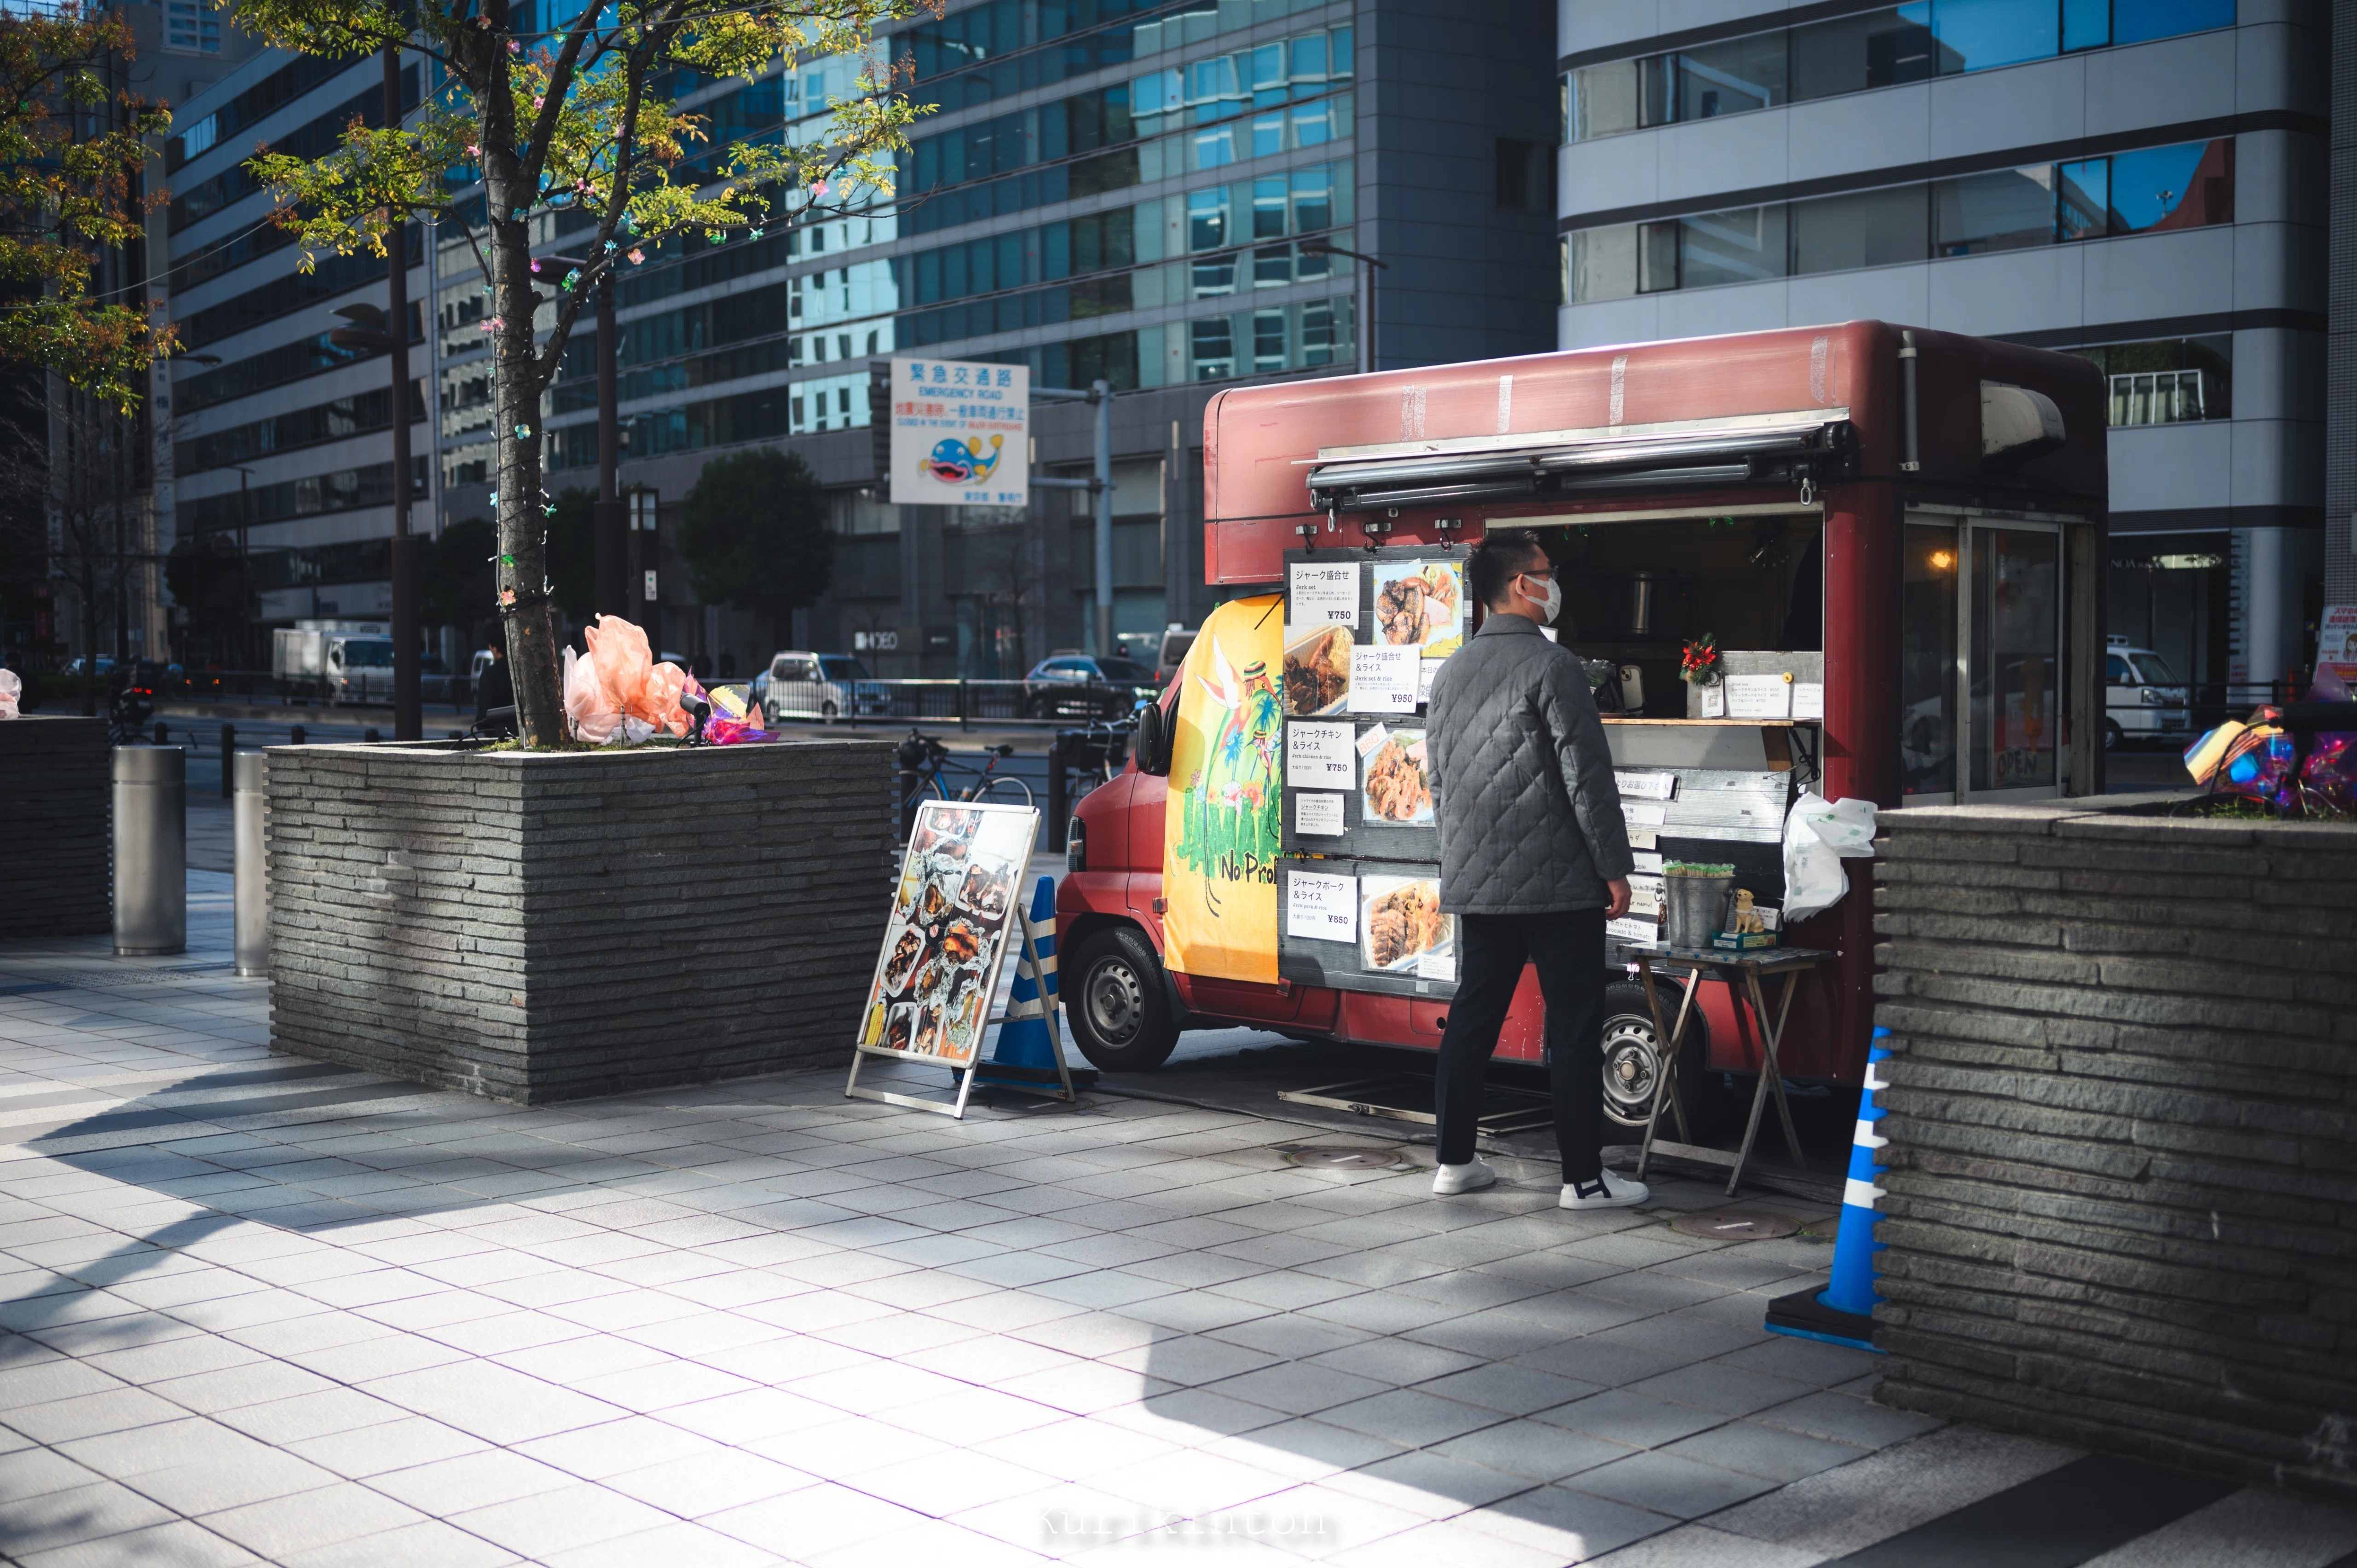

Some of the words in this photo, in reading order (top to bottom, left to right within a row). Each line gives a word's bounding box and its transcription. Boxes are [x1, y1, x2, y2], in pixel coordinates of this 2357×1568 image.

[910, 363, 1011, 387] 緊急交通路
[919, 386, 974, 398] EMERGENCY
[977, 389, 1003, 400] ROAD
[1296, 570, 1349, 580] ジャーク盛合せ
[1328, 611, 1351, 619] ¥750
[1356, 652, 1401, 661] ジャーク盛合せ
[1392, 694, 1412, 703] ¥950
[1293, 728, 1341, 739] ジャークチキン
[1293, 741, 1320, 750] &ライス
[1359, 733, 1380, 754] BBQ
[1997, 750, 2037, 778] OPEN
[1221, 849, 1241, 882] No
[1294, 878, 1344, 891] ジャークポーク
[1294, 890, 1322, 901] &ライス
[1328, 915, 1348, 924] ¥850
